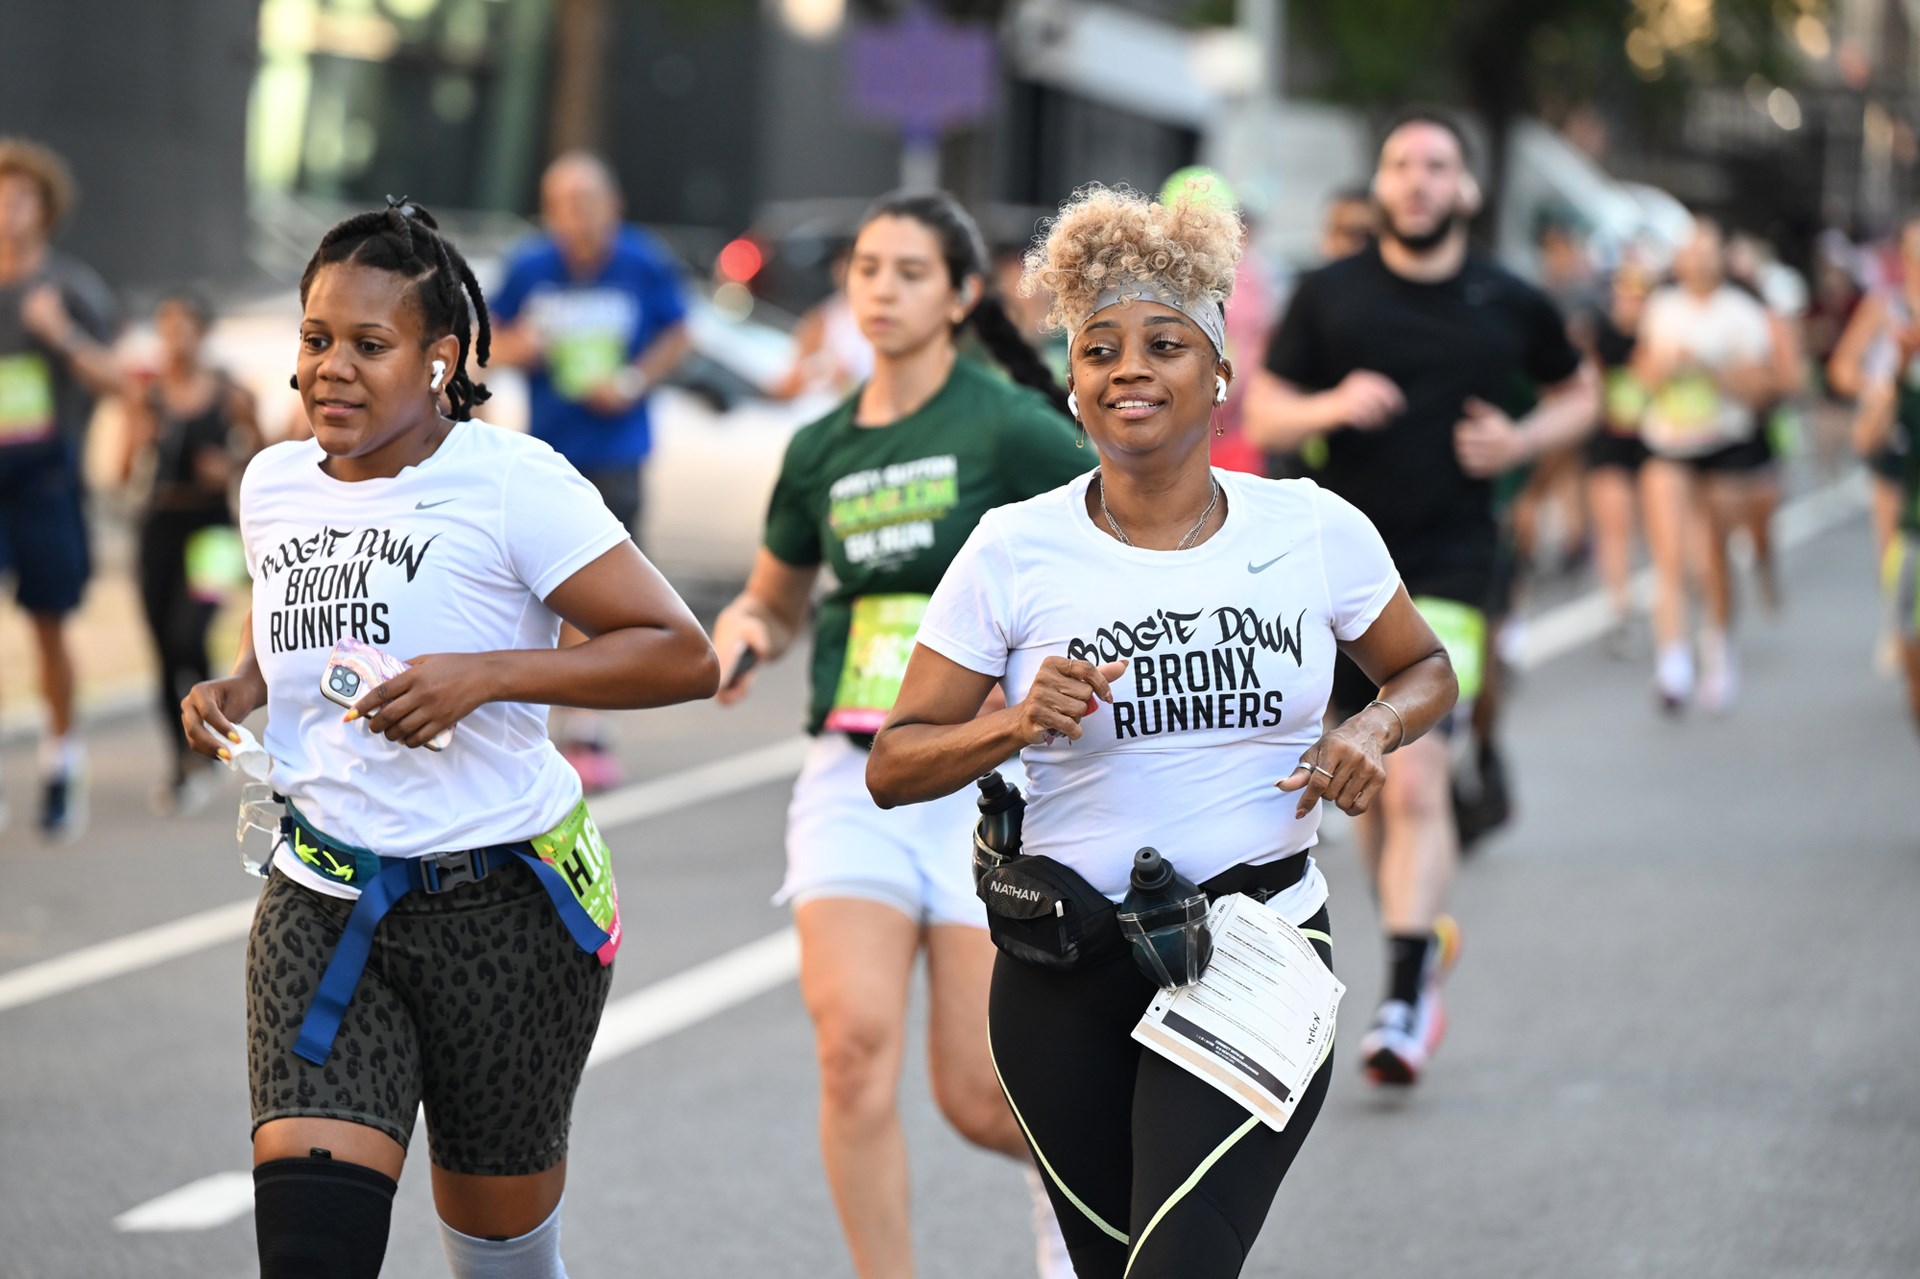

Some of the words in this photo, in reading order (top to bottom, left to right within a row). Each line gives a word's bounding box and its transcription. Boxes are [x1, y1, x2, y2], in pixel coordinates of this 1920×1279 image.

[285, 559, 373, 606] BRONX
[270, 602, 391, 654] RUNNERS
[1067, 607, 1204, 666] BOOGIE
[1208, 606, 1307, 668] DOWN
[1133, 646, 1262, 698] BRONX
[1112, 690, 1283, 740] RUNNERS
[990, 880, 1040, 903] NATHAN
